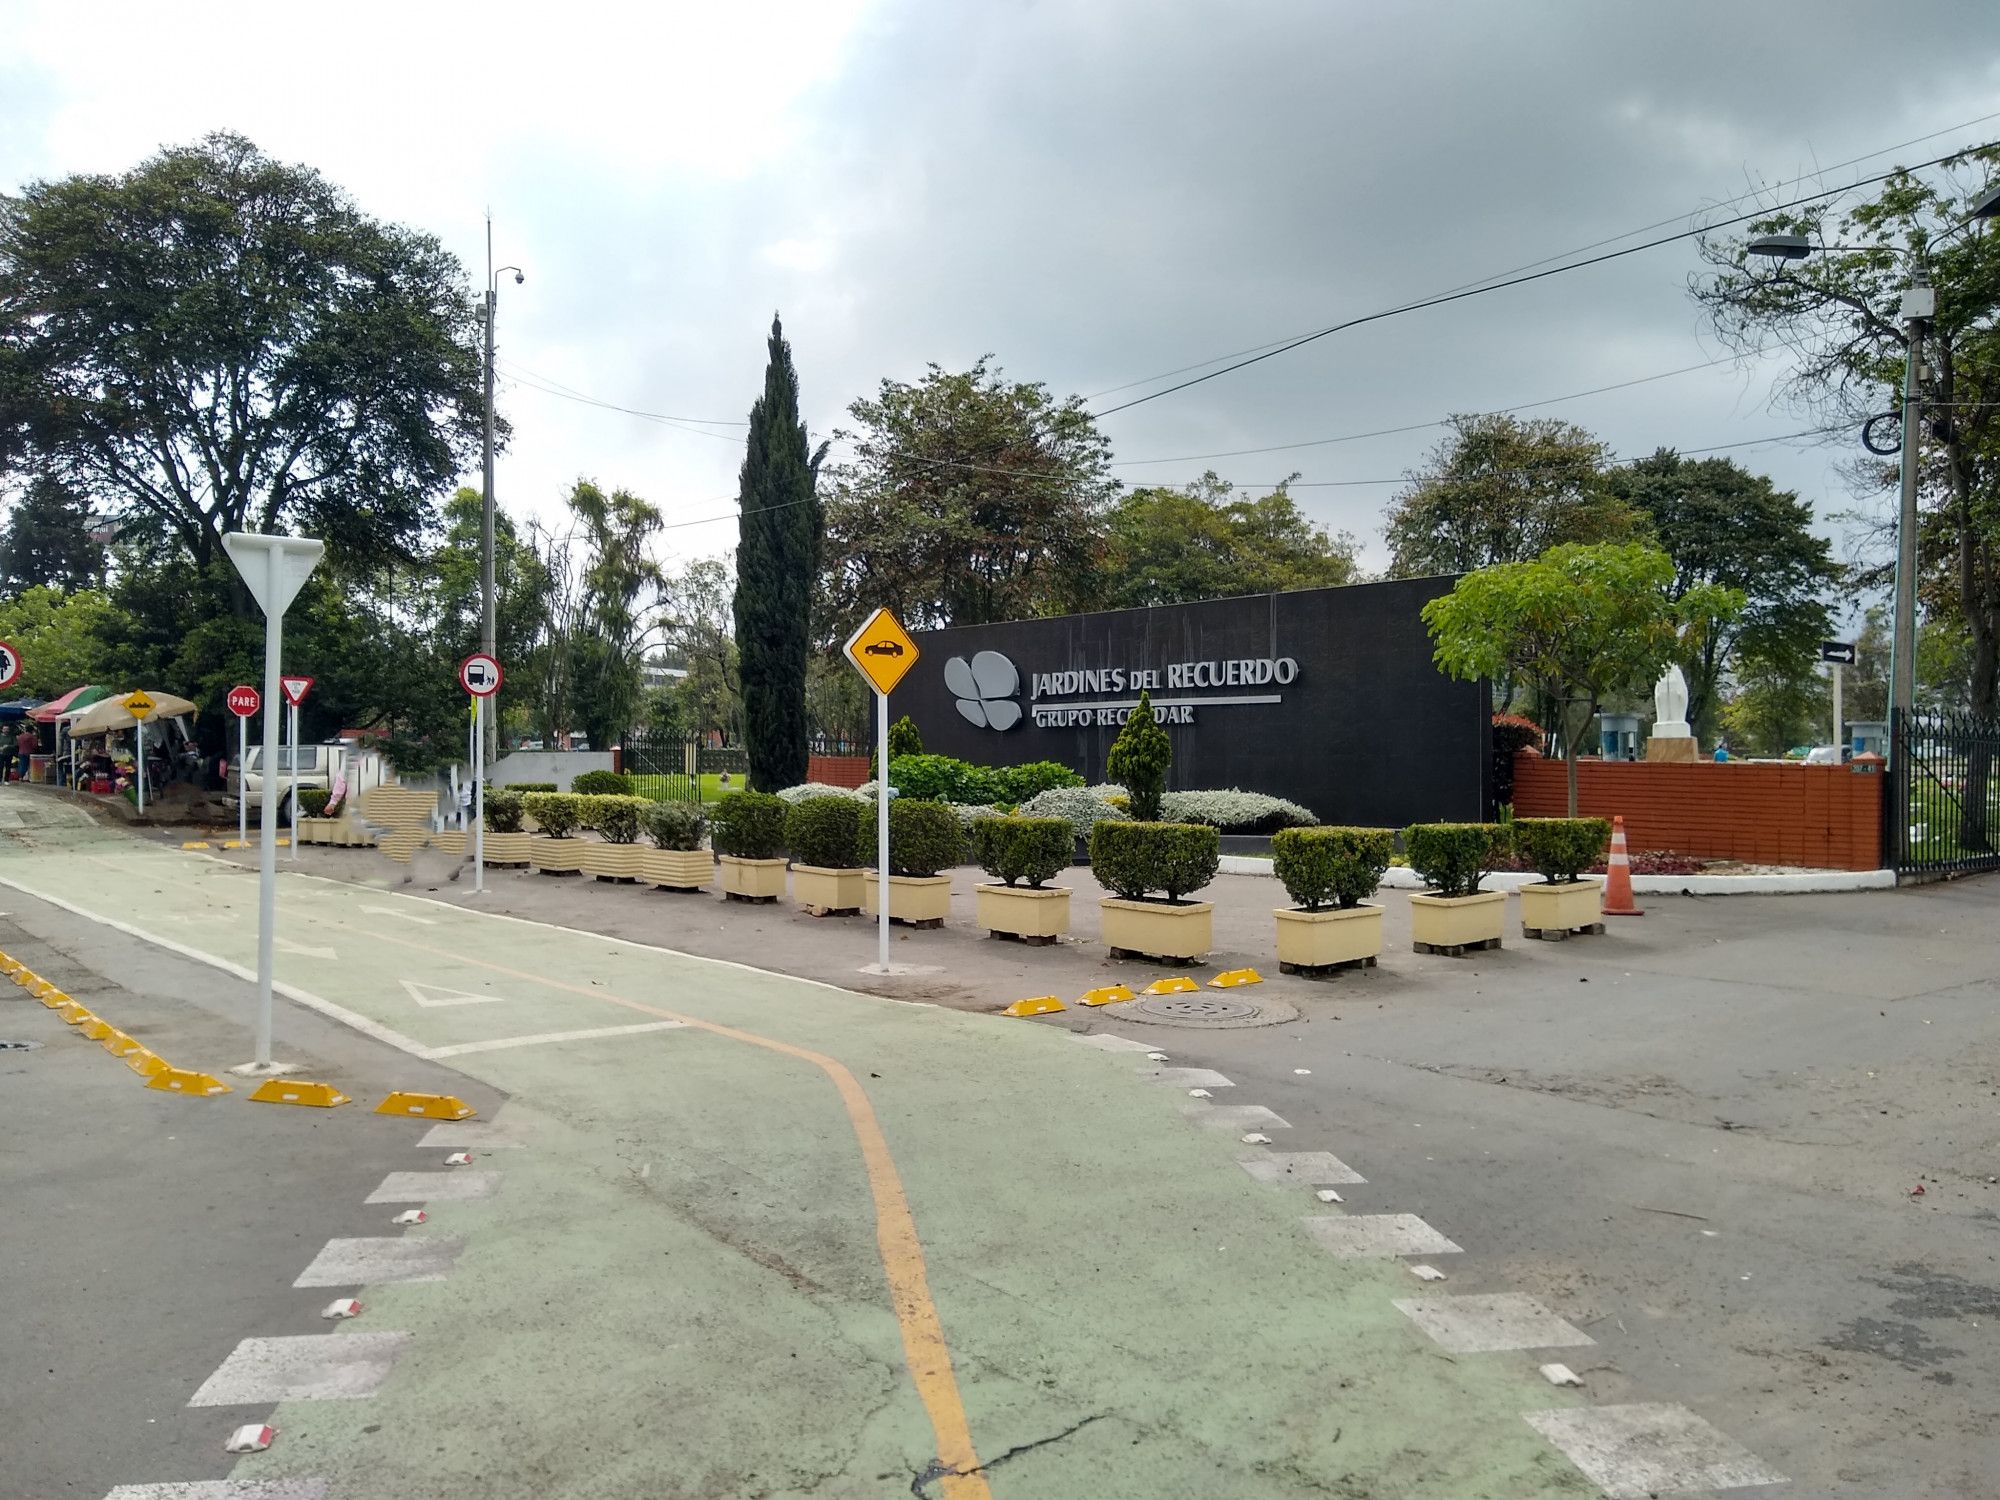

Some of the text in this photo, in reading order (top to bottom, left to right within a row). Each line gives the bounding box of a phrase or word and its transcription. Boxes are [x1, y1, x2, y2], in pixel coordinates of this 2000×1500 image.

[1031, 657, 1299, 700] JARDINES DEL RECUERDO
[232, 696, 256, 707] PARE
[1036, 705, 1195, 728] GRUPO RECDAR
